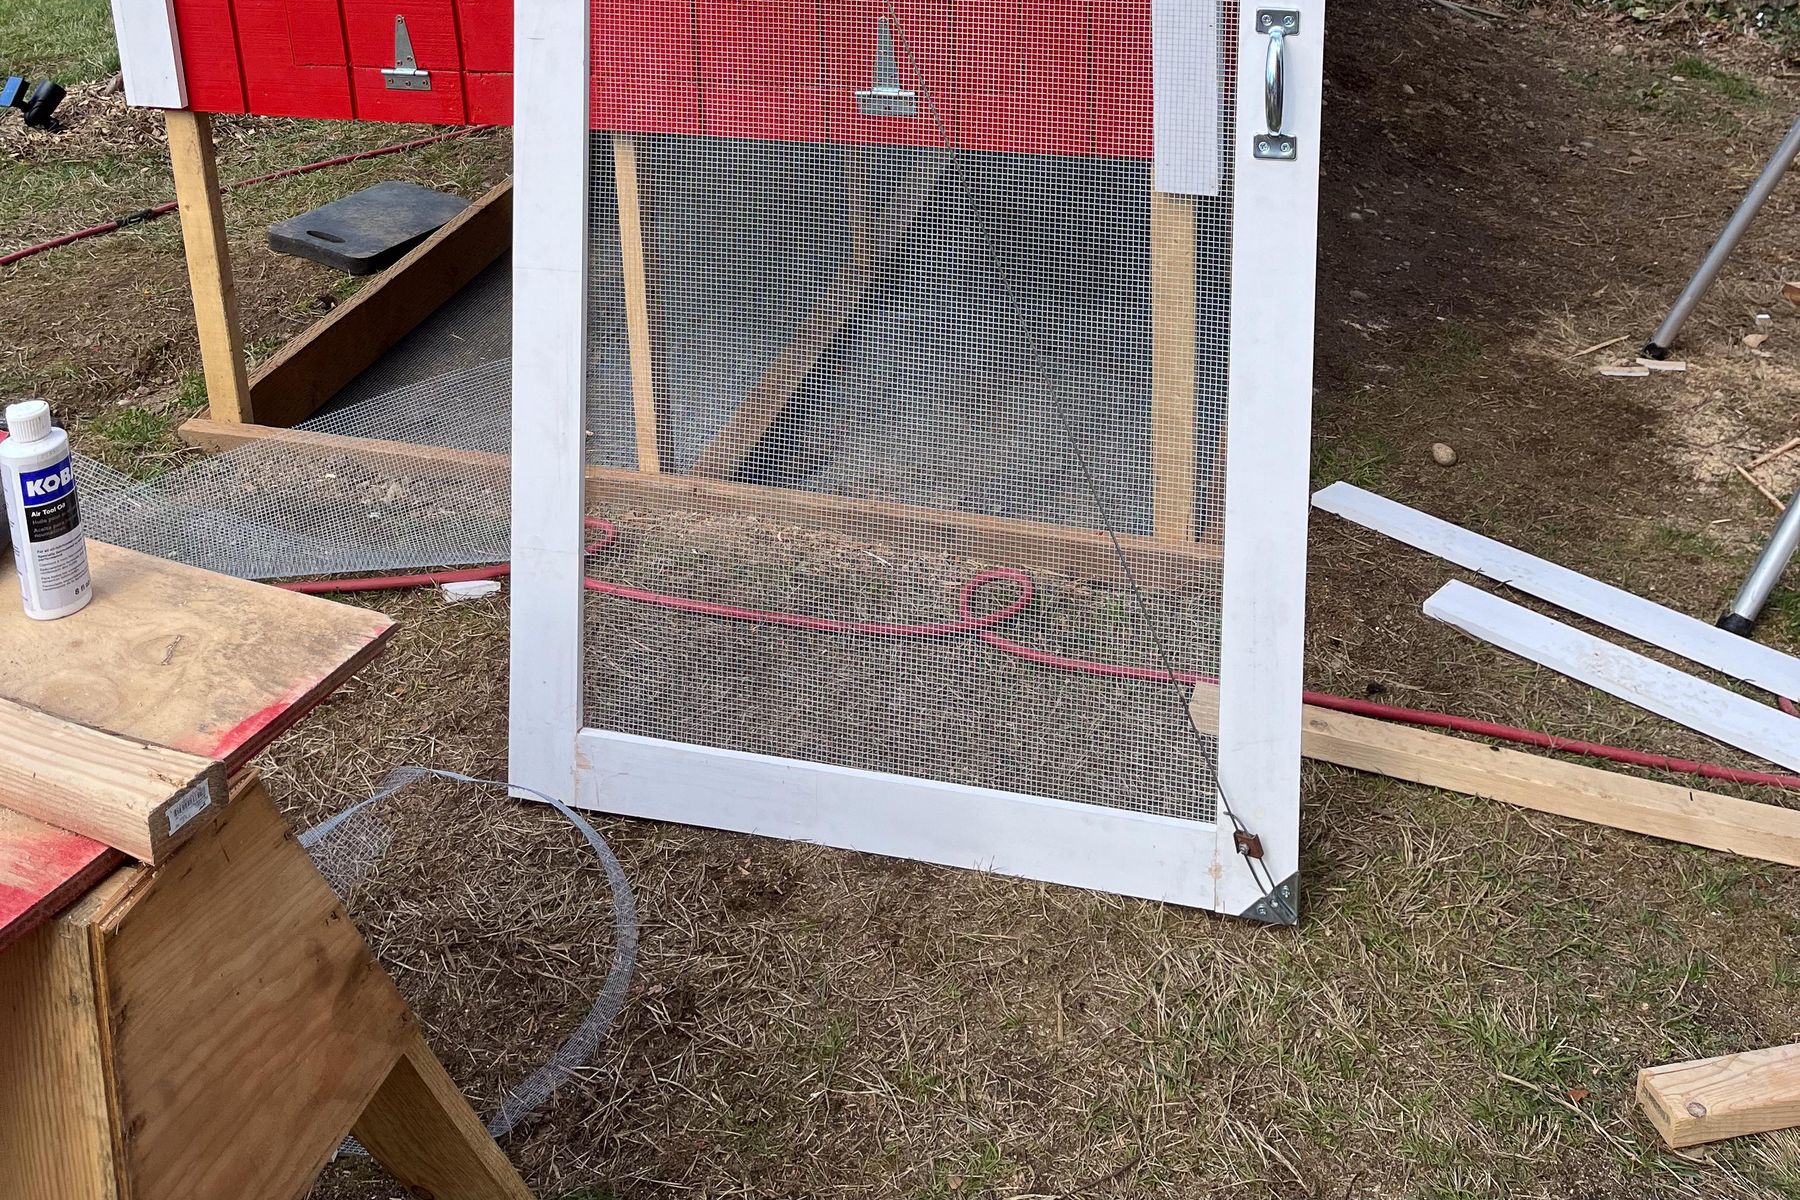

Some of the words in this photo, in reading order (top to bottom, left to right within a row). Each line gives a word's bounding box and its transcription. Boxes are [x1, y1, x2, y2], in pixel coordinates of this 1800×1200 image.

[26, 466, 72, 497] KOB
[42, 506, 56, 515] Tool
[57, 502, 66, 510] Oil
